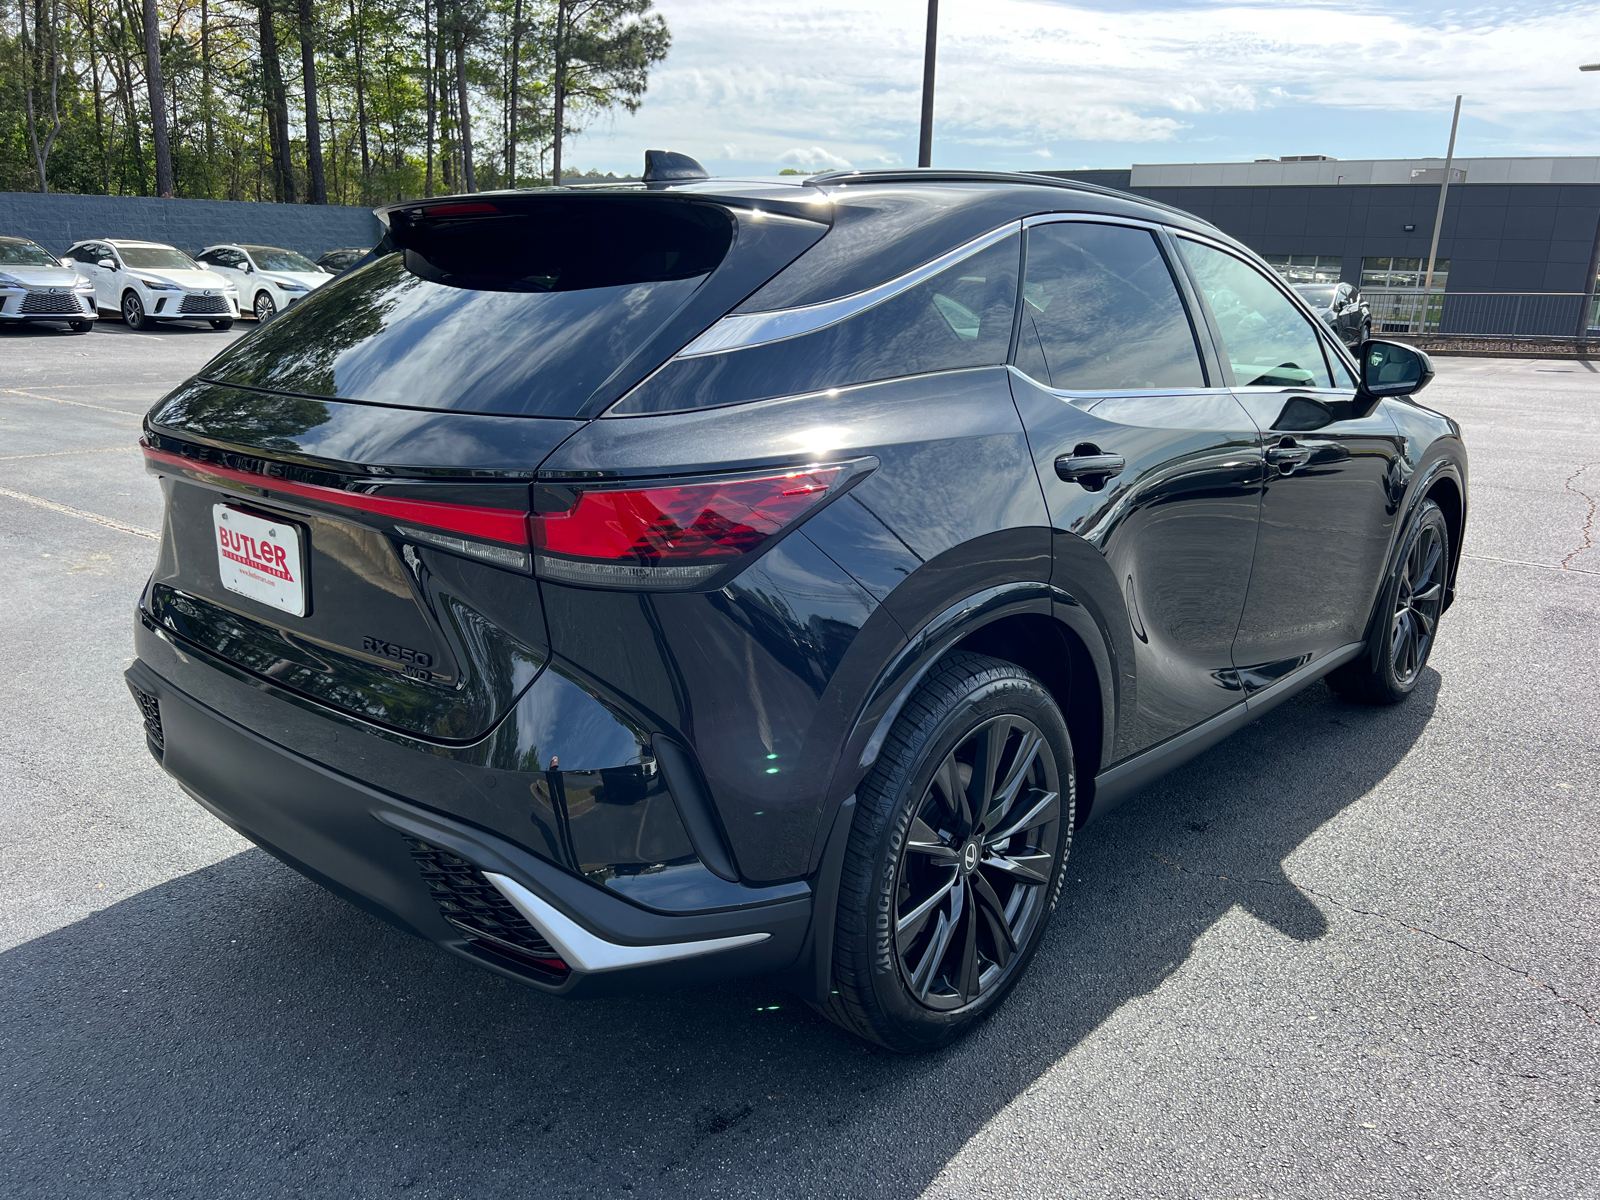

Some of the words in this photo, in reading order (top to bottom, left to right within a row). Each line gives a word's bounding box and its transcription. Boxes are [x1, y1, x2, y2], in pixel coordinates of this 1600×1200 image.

[180, 443, 284, 477] LEXUS
[267, 567, 291, 580] GROUP
[399, 665, 433, 682] AWD
[875, 800, 914, 975] BRIDGESTONE
